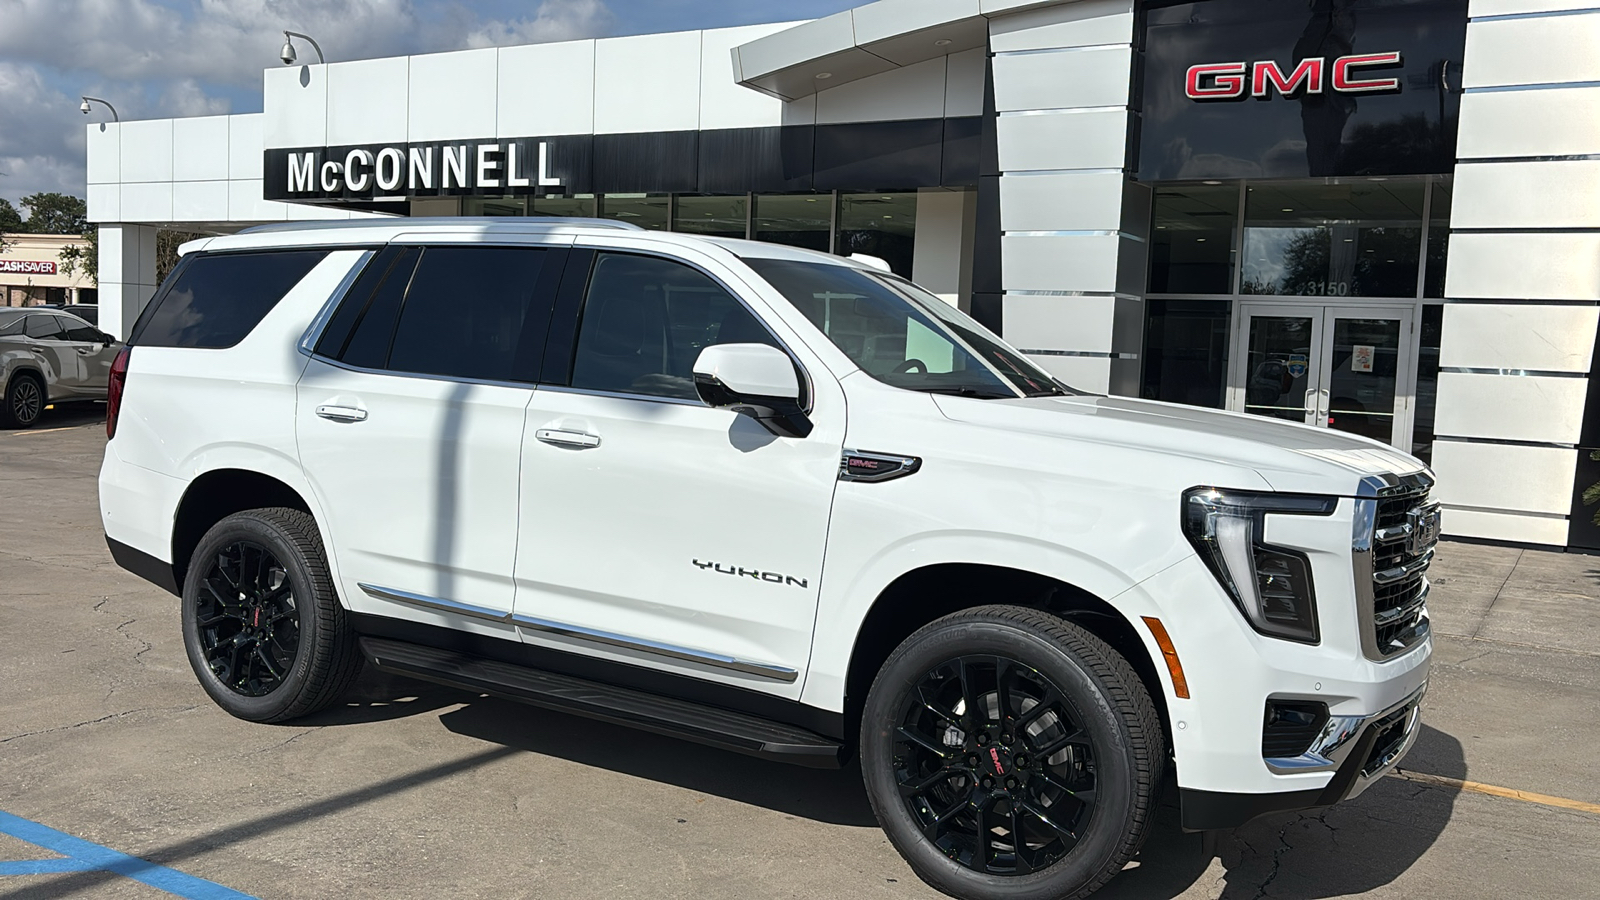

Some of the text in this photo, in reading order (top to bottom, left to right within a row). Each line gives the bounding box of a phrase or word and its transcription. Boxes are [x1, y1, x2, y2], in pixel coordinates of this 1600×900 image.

[1185, 51, 1401, 99] GMC
[287, 141, 562, 193] McCONNELL
[1306, 281, 1347, 296] 3150
[849, 458, 878, 469] GMC
[692, 558, 808, 589] YUKON
[989, 747, 1005, 775] GMC
